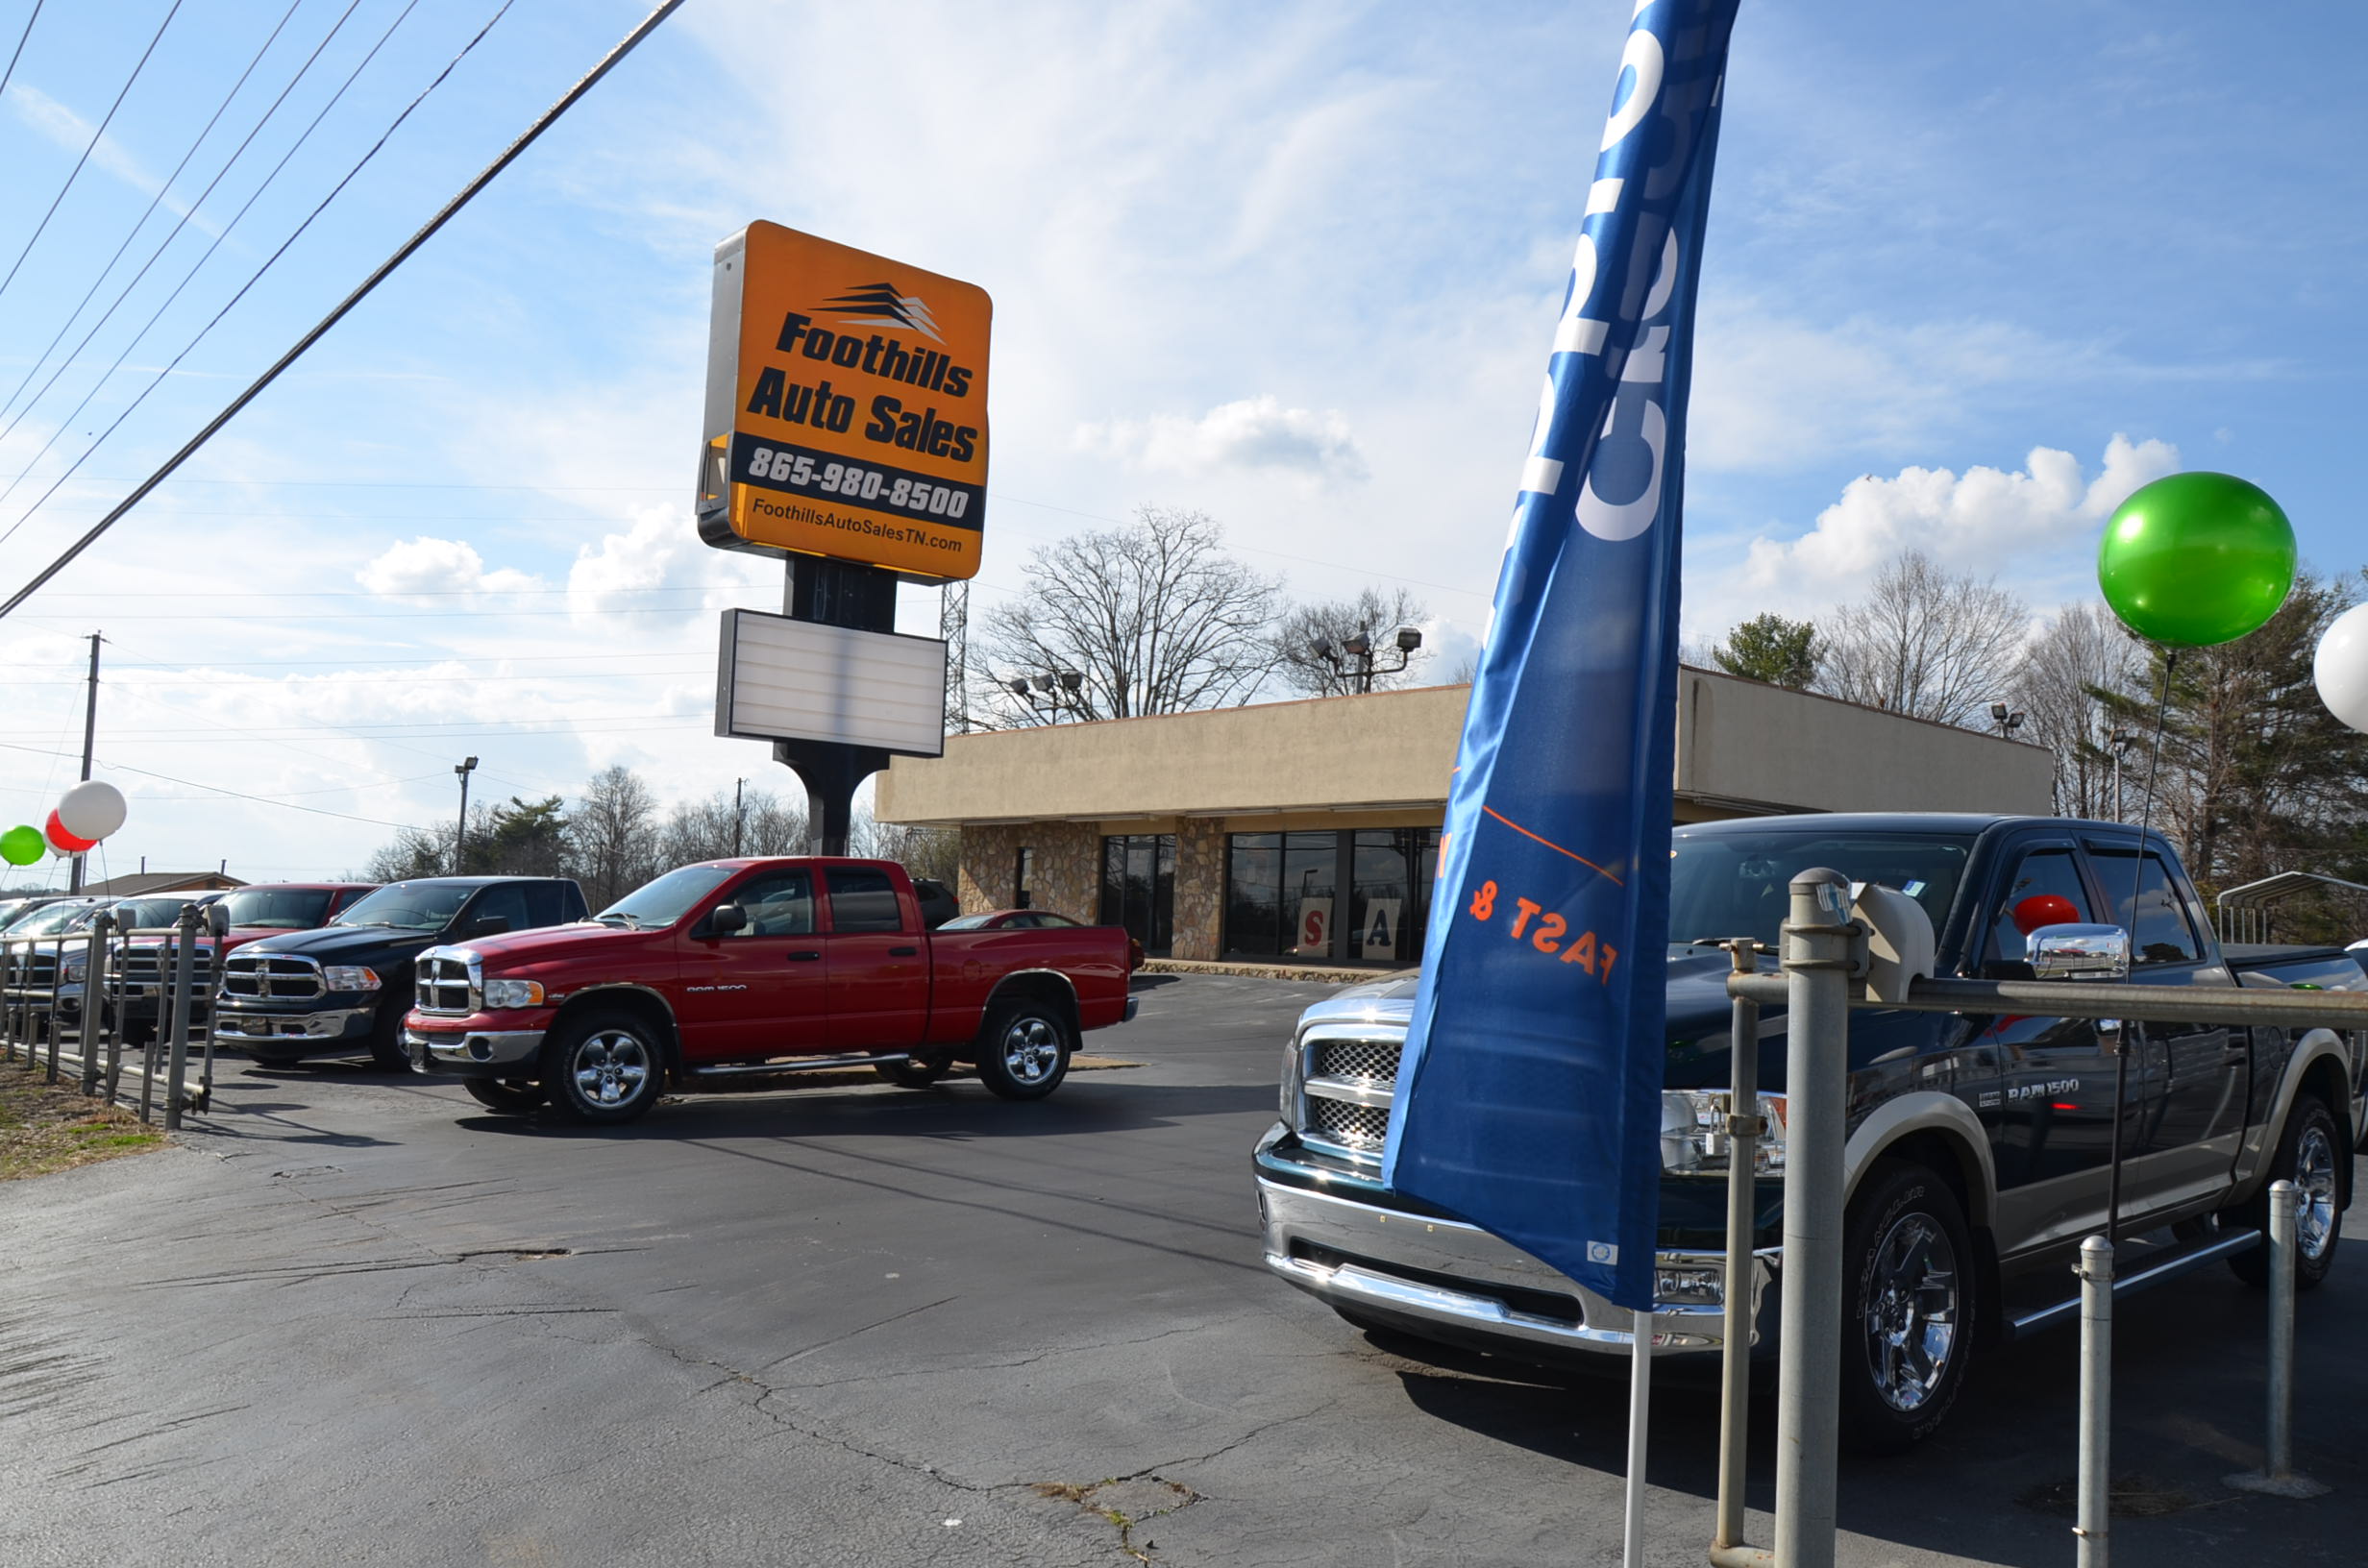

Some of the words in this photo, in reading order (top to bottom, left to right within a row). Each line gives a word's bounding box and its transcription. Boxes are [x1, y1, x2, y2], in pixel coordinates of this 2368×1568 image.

[776, 311, 973, 398] Foothills
[746, 366, 856, 433] Auto
[864, 395, 978, 462] Sales
[749, 447, 970, 519] 865-980-8500
[752, 498, 962, 552] FoothillsAutoSalesTN.com
[1304, 910, 1323, 946] S
[1367, 909, 1392, 946] A
[2008, 1083, 2045, 1102] RAM
[2046, 1078, 2080, 1096] 1500
